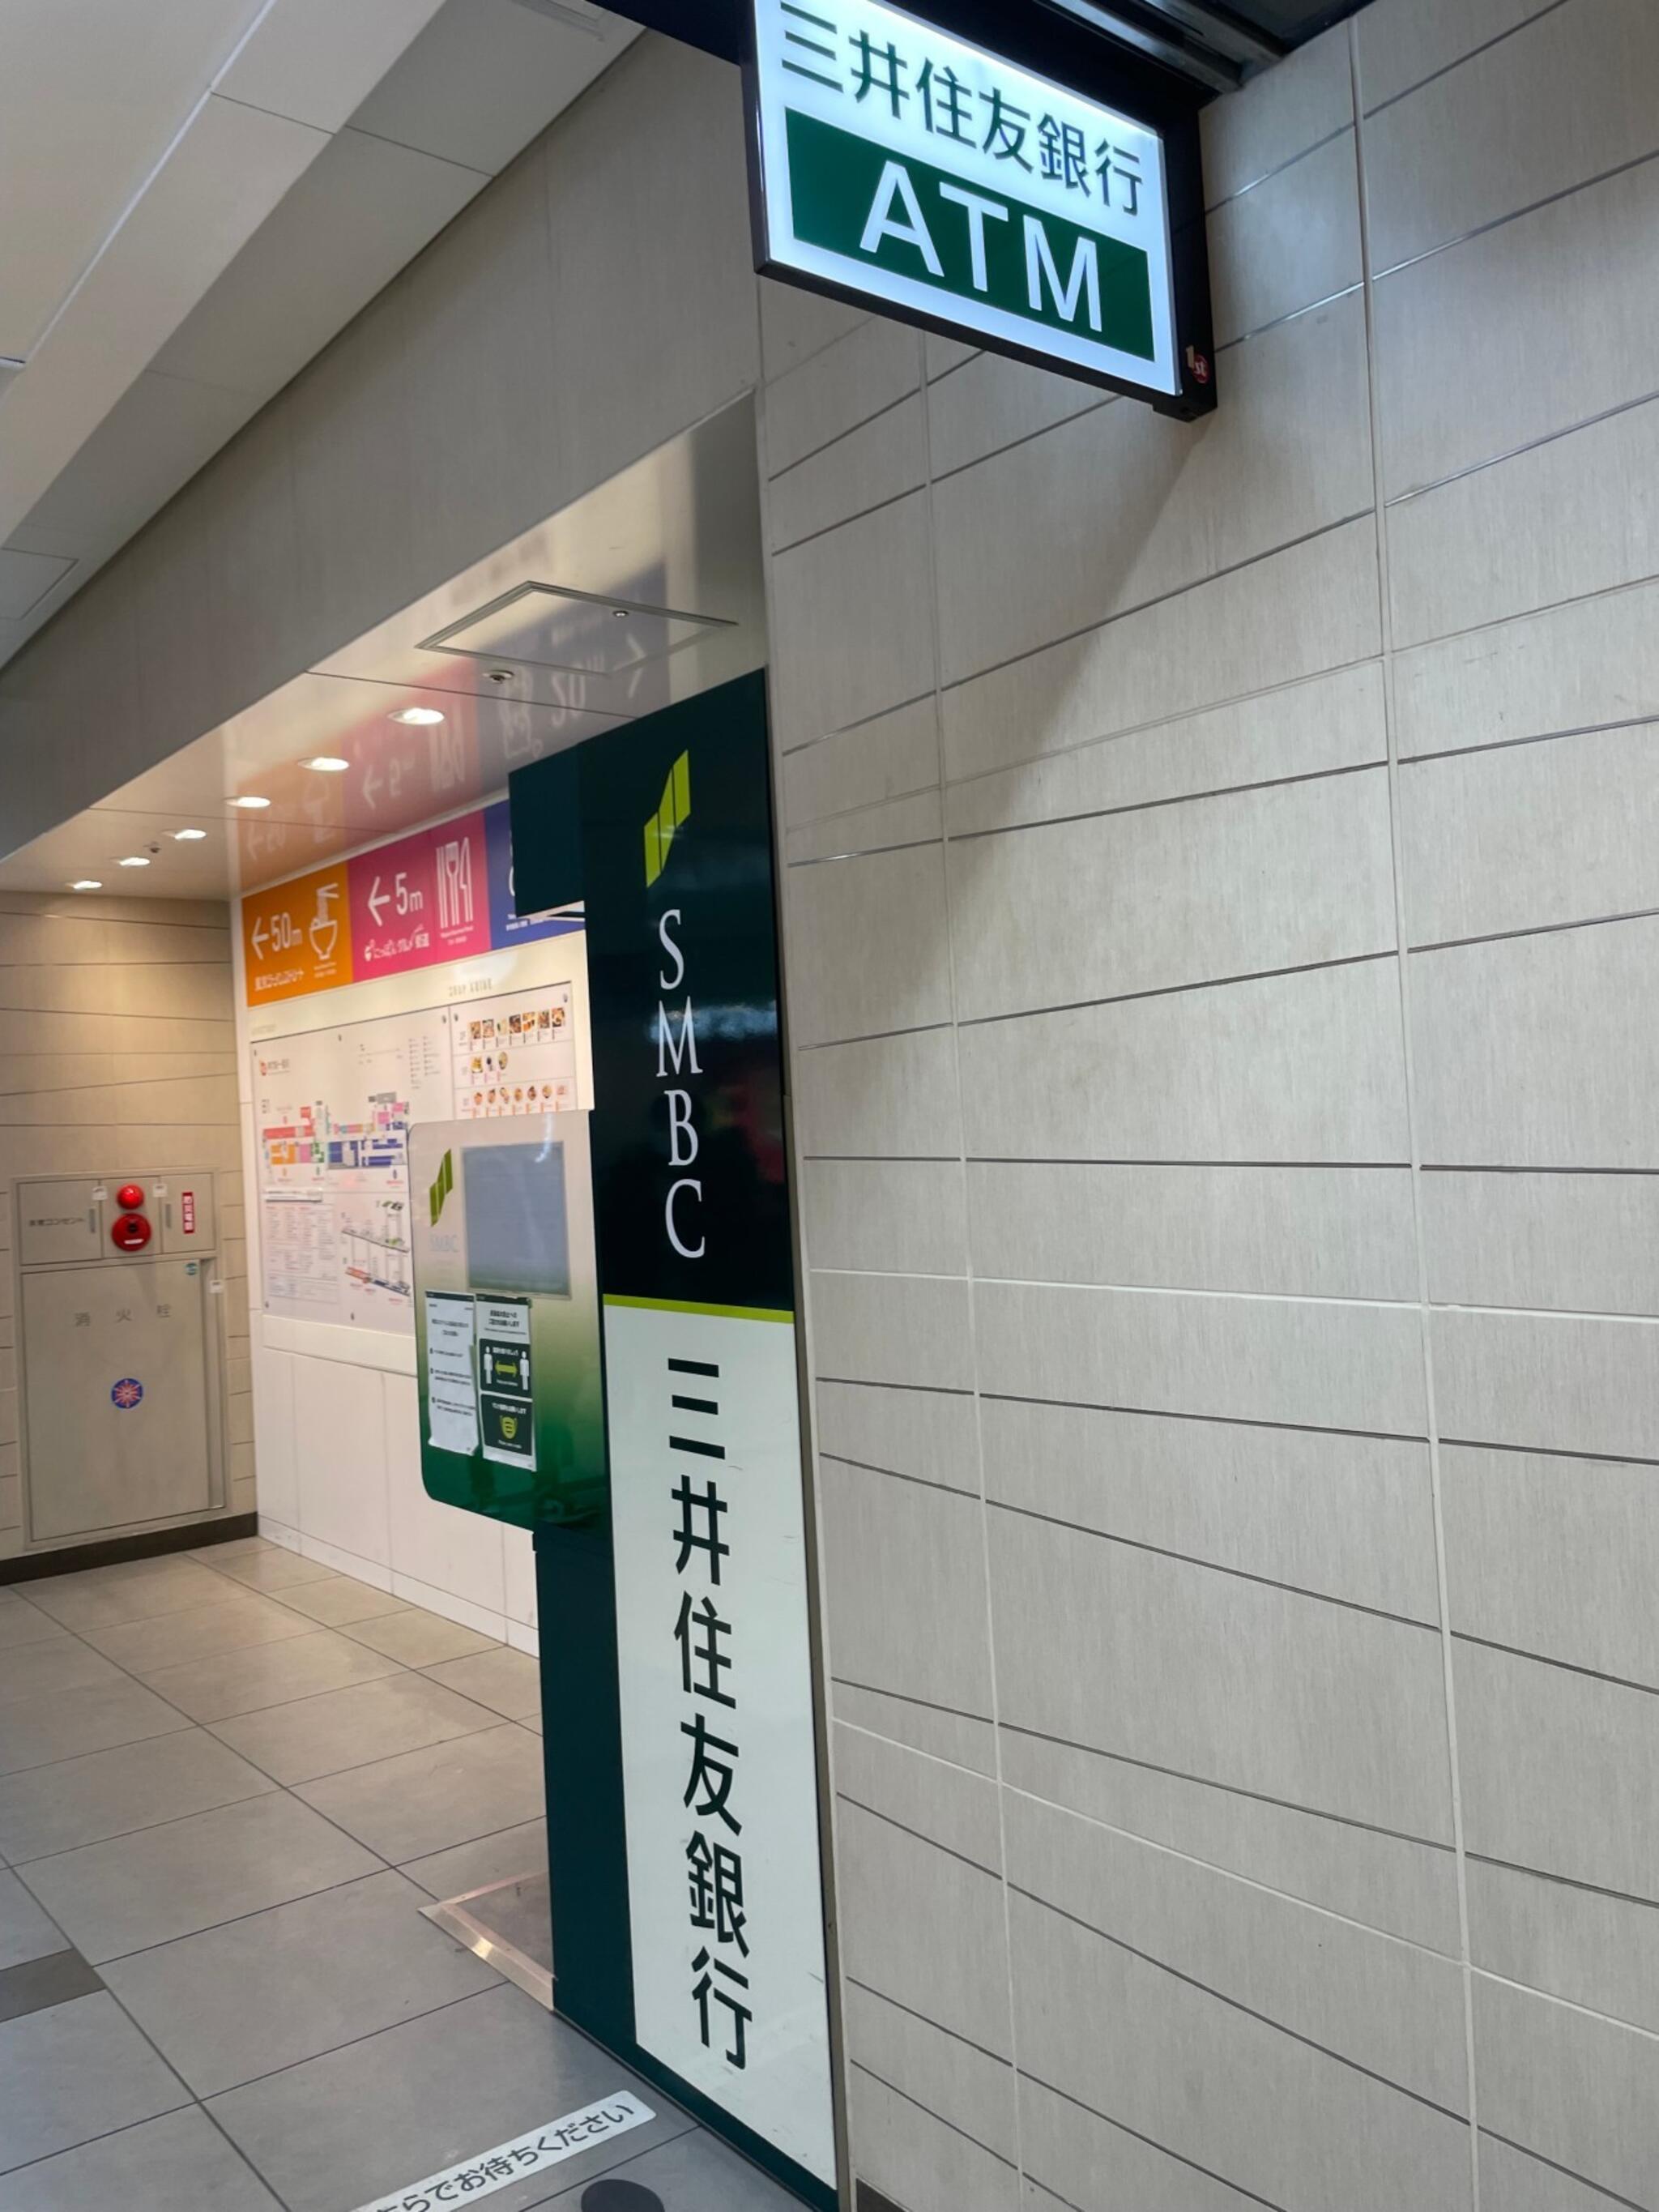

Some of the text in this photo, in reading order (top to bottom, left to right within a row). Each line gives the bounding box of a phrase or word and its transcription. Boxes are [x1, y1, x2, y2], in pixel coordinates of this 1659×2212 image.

[780, 2, 1142, 216] 三井住友銀行
[859, 160, 1102, 333] ATM
[271, 912, 303, 952] 50m
[395, 872, 424, 916] 5m
[656, 909, 706, 1258] SMBC
[667, 1358, 753, 2070] 三井住友銀行
